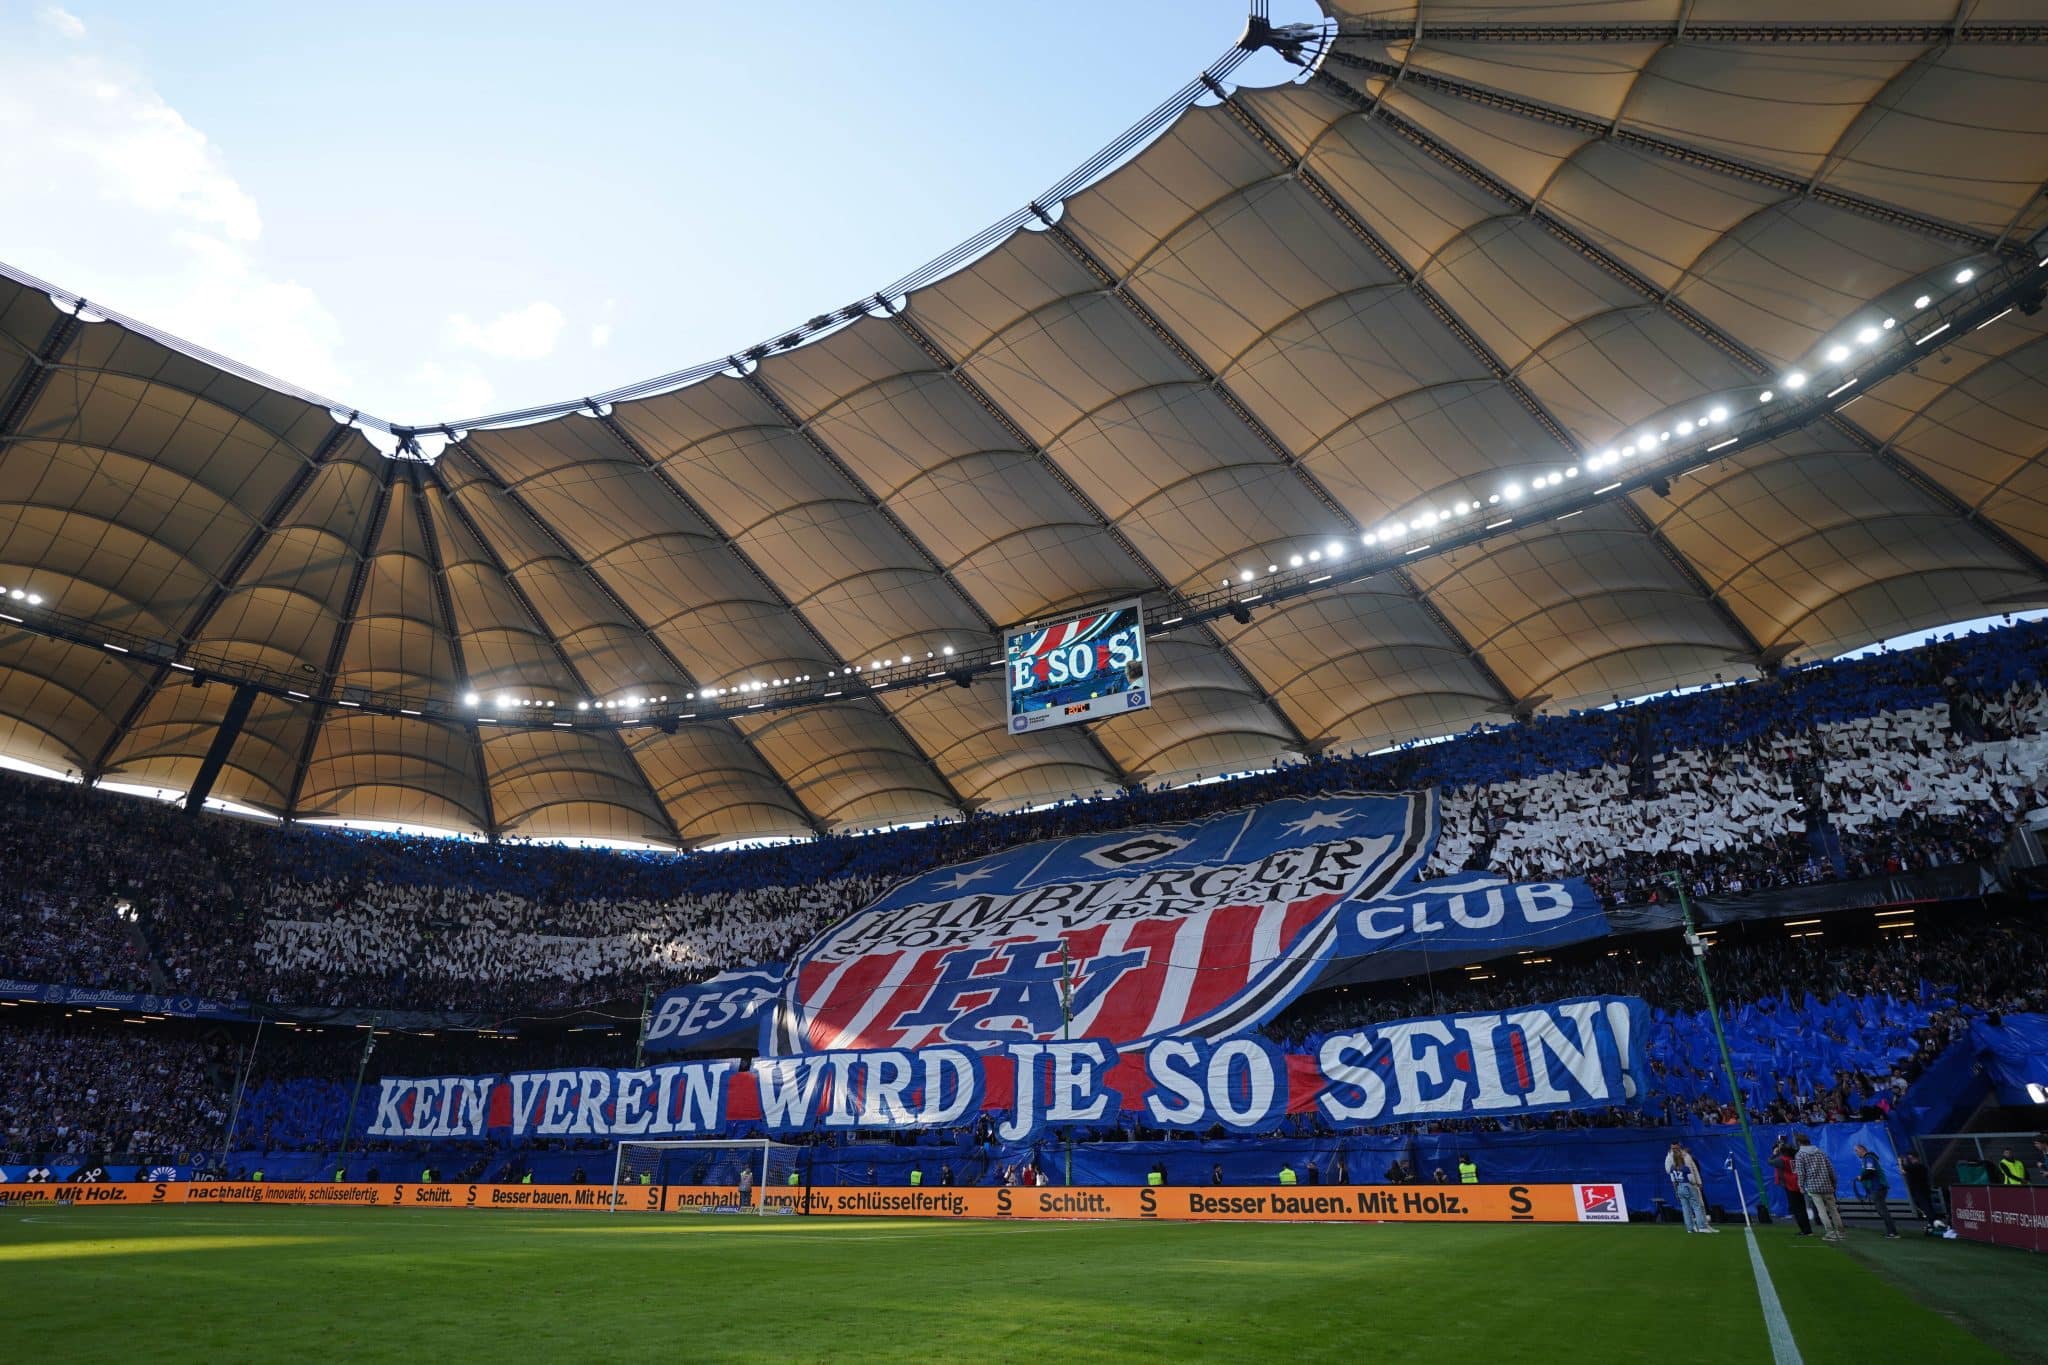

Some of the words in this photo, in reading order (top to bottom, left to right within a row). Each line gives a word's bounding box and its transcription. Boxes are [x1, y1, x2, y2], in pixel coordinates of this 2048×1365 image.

[1048, 644, 1093, 683] SO
[849, 838, 1367, 945] HAMBURGER
[1356, 883, 1574, 940] CLUB
[648, 987, 782, 1040] BEST
[367, 1078, 495, 1137] KEIN
[509, 1063, 731, 1136] VEREIN
[752, 1049, 973, 1129] WIRD
[998, 1041, 1112, 1142] JE
[1147, 1039, 1274, 1128] SO
[1319, 1000, 1637, 1122] SEIN!
[54, 1187, 83, 1201] Mit
[85, 1187, 127, 1201] Holz.
[152, 1184, 168, 1201] S
[188, 1185, 264, 1201] nachhaltig,
[266, 1186, 306, 1202] innovativ,
[309, 1186, 379, 1204] schlüsselfertig.
[394, 1185, 404, 1202] S
[416, 1187, 452, 1202] Schütt.
[467, 1185, 477, 1203] S
[492, 1189, 531, 1204] Besser
[533, 1190, 571, 1205] bauen.
[575, 1190, 594, 1205] Mit
[648, 1187, 659, 1207] S
[838, 1192, 969, 1215] schlüsselfertig.
[997, 1189, 1012, 1213] S
[1040, 1192, 1111, 1213] Schütt.
[1140, 1189, 1157, 1214] S
[1189, 1192, 1266, 1214] Besser
[1271, 1193, 1352, 1214] bauen.
[1358, 1191, 1398, 1214] Mit
[1403, 1192, 1468, 1214] Holz.
[1510, 1186, 1533, 1216] S
[1606, 1199, 1617, 1211] 2
